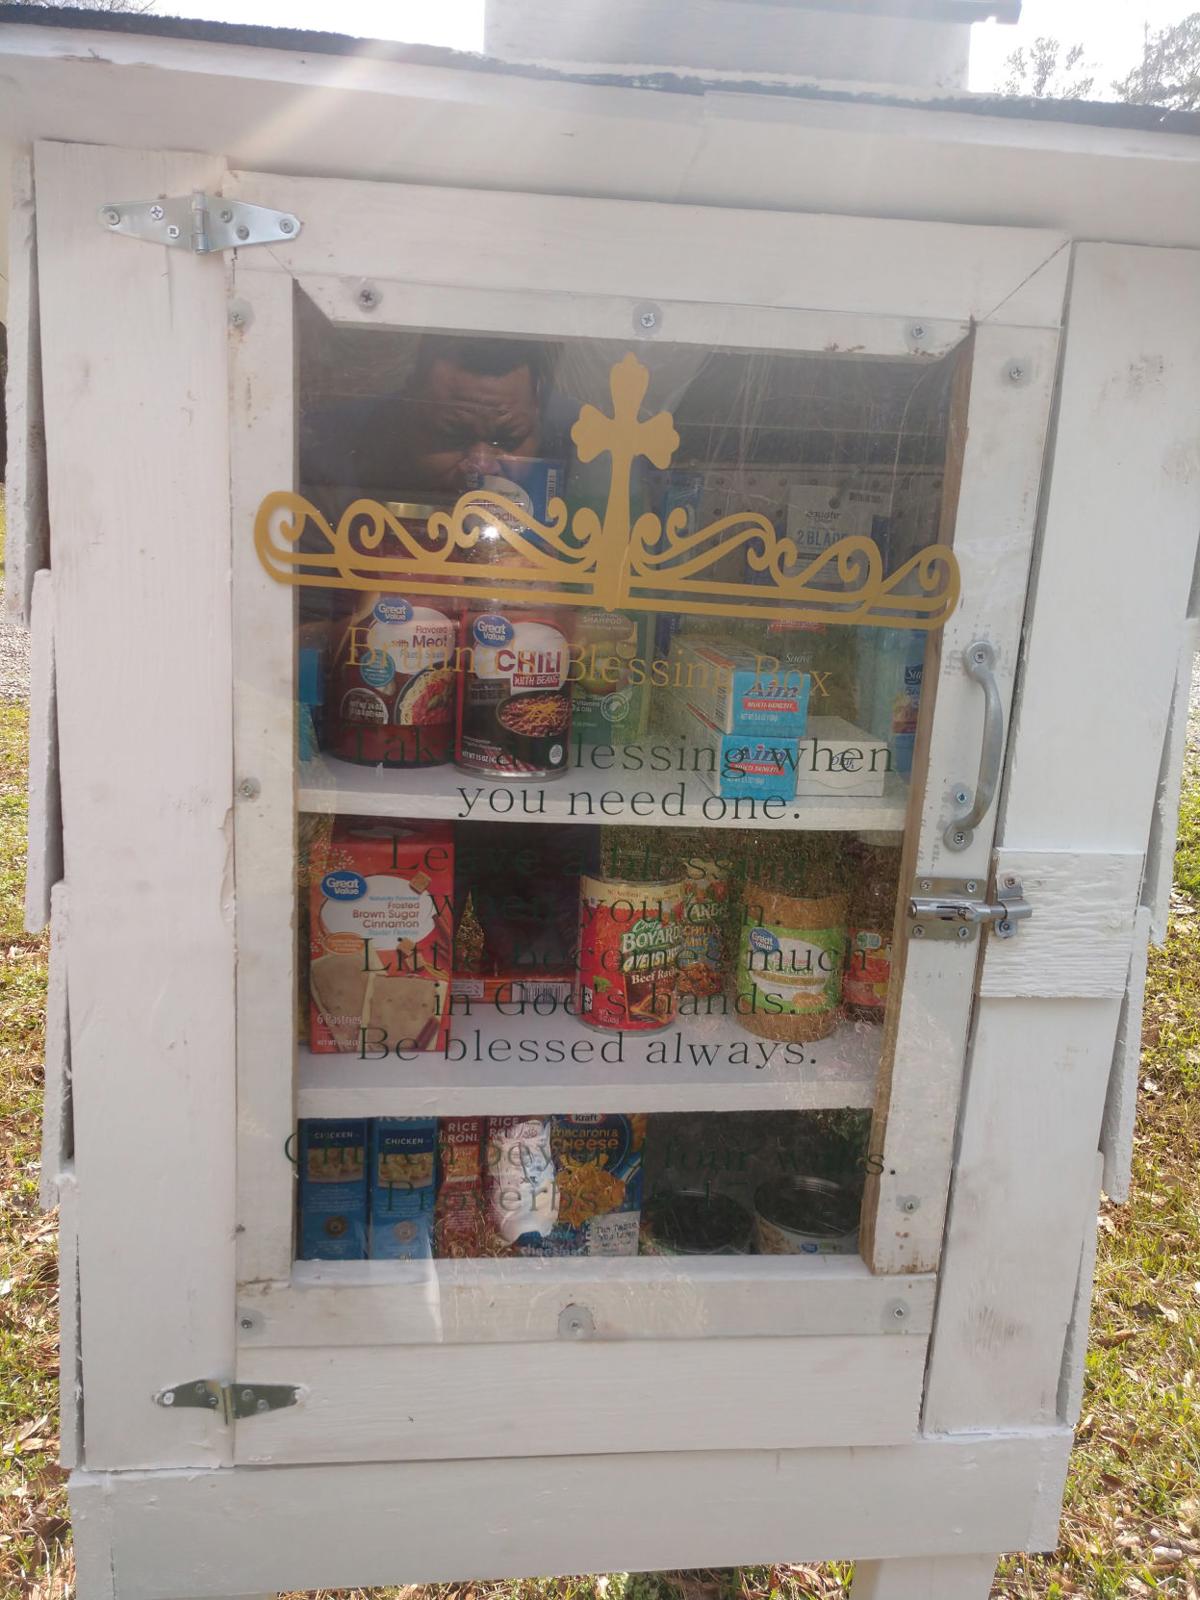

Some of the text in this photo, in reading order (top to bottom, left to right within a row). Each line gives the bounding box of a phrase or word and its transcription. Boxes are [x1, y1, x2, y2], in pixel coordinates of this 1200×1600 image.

[378, 603, 407, 616] Great
[384, 612, 407, 621] Value
[477, 621, 506, 635] Great
[483, 632, 506, 641] Value
[495, 649, 561, 673] CHILI
[561, 643, 733, 697] Blessing
[754, 654, 833, 698] Box
[744, 680, 799, 698] Aim
[768, 737, 895, 773] when
[457, 783, 801, 821] you need one.
[389, 836, 543, 875] Leave
[326, 876, 359, 888] Great
[334, 887, 359, 895] Value
[387, 901, 420, 909] Frosted
[352, 909, 420, 920] Brown Sugar
[582, 899, 663, 928] you
[362, 920, 420, 929] Cinnamon
[751, 931, 774, 944] Great
[746, 935, 870, 972] much
[631, 973, 656, 985] Beef
[434, 982, 472, 1017] in
[650, 982, 797, 1017] hands.
[317, 1012, 362, 1025] 6 Pastries
[358, 1027, 818, 1070] Be blessed always.
[489, 1117, 520, 1127] RICE
[575, 1113, 598, 1122] Kraft
[448, 1121, 479, 1132] RICE
[448, 1133, 478, 1144] RONI
